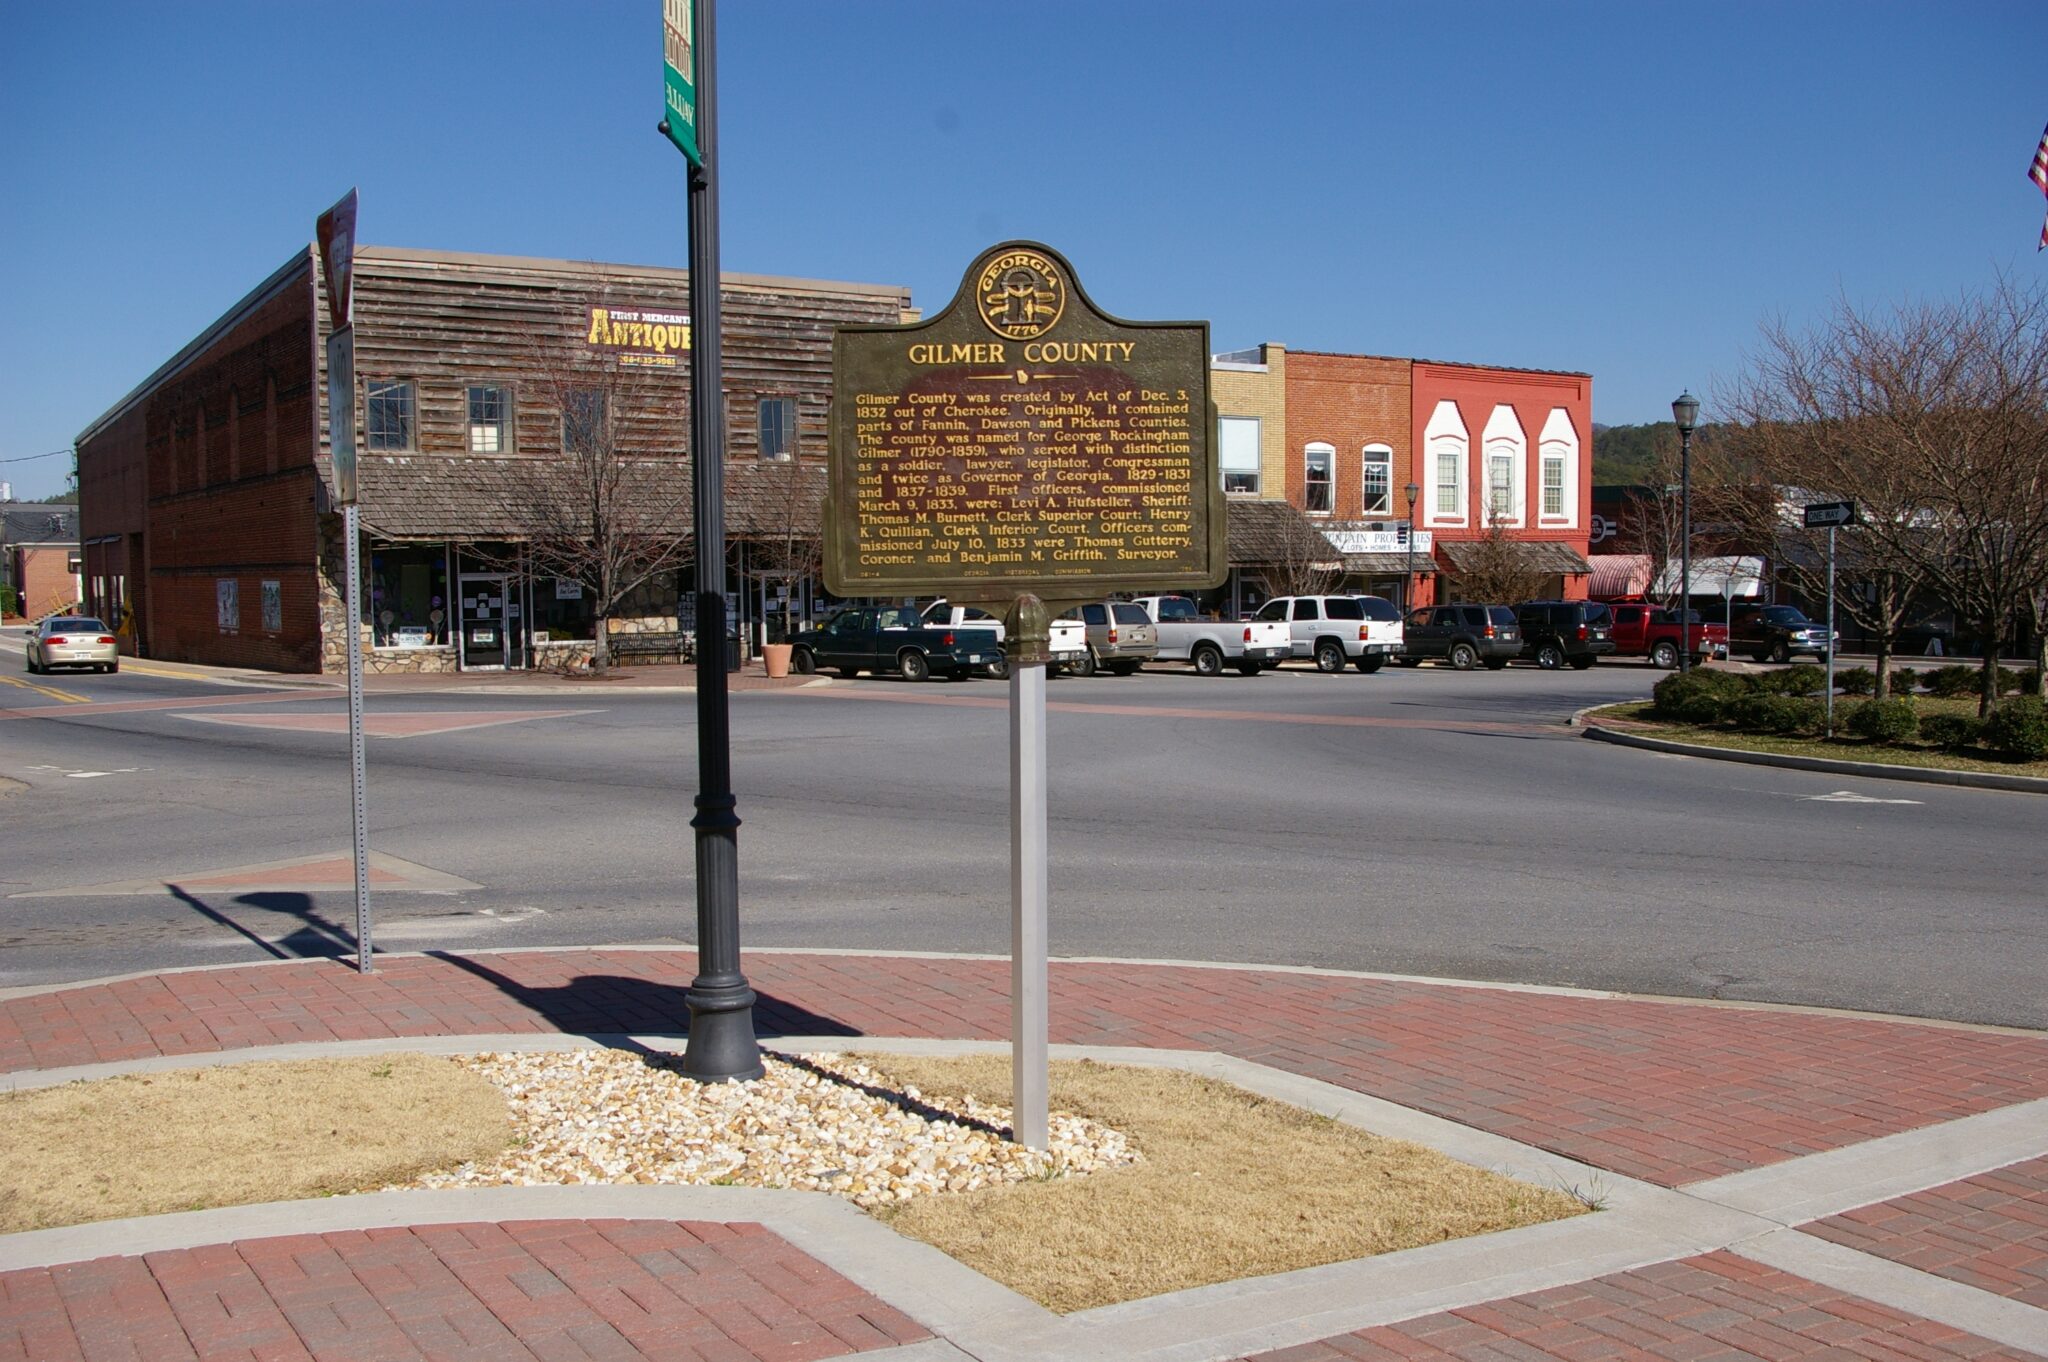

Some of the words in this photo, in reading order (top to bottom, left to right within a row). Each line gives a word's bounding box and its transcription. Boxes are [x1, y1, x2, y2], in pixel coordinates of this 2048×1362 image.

[982, 255, 1058, 292] GEORGIA
[610, 310, 640, 321] FIRST
[1007, 325, 1040, 336] 1776
[908, 343, 1006, 365] GILMER
[1023, 341, 1136, 364] COUNTY
[333, 351, 347, 391] NO
[856, 394, 900, 405] Gilmer
[907, 392, 957, 405] County
[965, 394, 991, 403] was
[999, 391, 1051, 403] created
[1060, 391, 1076, 403] by
[1085, 390, 1109, 402] Act
[1117, 390, 1132, 402] of
[1140, 389, 1170, 401] Dec.
[856, 407, 887, 419] 1832
[893, 406, 916, 418] out
[922, 406, 937, 418] of
[943, 405, 1011, 417] Cherokee.
[1107, 403, 1118, 415] it
[1124, 402, 1189, 415] contained
[857, 420, 893, 433] parts
[899, 419, 915, 431] of
[981, 418, 1031, 430] Dawson
[1038, 417, 1063, 429] and
[1070, 417, 1121, 429] Pickens
[1128, 416, 1190, 428] Counties.
[856, 433, 883, 445] The
[890, 433, 937, 445] county
[945, 434, 970, 444] was
[976, 431, 1020, 443] named
[1027, 431, 1047, 442] for
[1054, 430, 1103, 443] George
[1109, 429, 1190, 442] Rockingham
[856, 447, 902, 459] Gilmer
[999, 444, 1026, 456] who
[1032, 444, 1077, 456] served
[1084, 443, 1114, 455] with
[1122, 442, 1191, 455] distinction
[857, 462, 872, 472] as
[880, 462, 889, 472] a
[1103, 457, 1191, 470] Congressman
[858, 473, 883, 485] and
[891, 472, 929, 485] twice
[937, 474, 952, 484] as
[960, 472, 1024, 483] Governor
[1032, 470, 1048, 482] of
[1127, 468, 1191, 481] 1829-1831
[857, 487, 883, 498] and
[896, 485, 969, 498] 1837-1839.
[988, 484, 1019, 496] First
[1101, 482, 1191, 494] commissioned
[858, 499, 901, 512] March
[965, 499, 1002, 510] were:
[1011, 497, 1039, 509] Levi
[1046, 497, 1060, 508] A.
[858, 513, 910, 525] Thomas
[915, 512, 931, 524] M.
[996, 511, 1032, 522] Clerk
[1038, 510, 1095, 523] Superior
[1150, 509, 1191, 521] Henry
[1809, 511, 1823, 521] ONE
[1825, 509, 1840, 520] WAY
[859, 526, 873, 538] K.
[943, 525, 980, 537] Clerk
[989, 524, 1040, 536] Inferior
[1047, 523, 1090, 534] Court.
[1100, 522, 1154, 534] Officers
[1161, 523, 1193, 533] com-
[859, 539, 923, 552] missioned
[931, 538, 960, 551] July
[996, 537, 1026, 549] 1833
[1033, 538, 1066, 548] were
[1073, 536, 1125, 548] Thomas
[1326, 533, 1367, 544] UNTAIN
[1374, 533, 1431, 544] PROPTIES
[926, 552, 951, 563] and
[959, 550, 1023, 563] Benjamin
[1030, 550, 1046, 562] M.
[1116, 549, 1179, 561] Surveyor.
